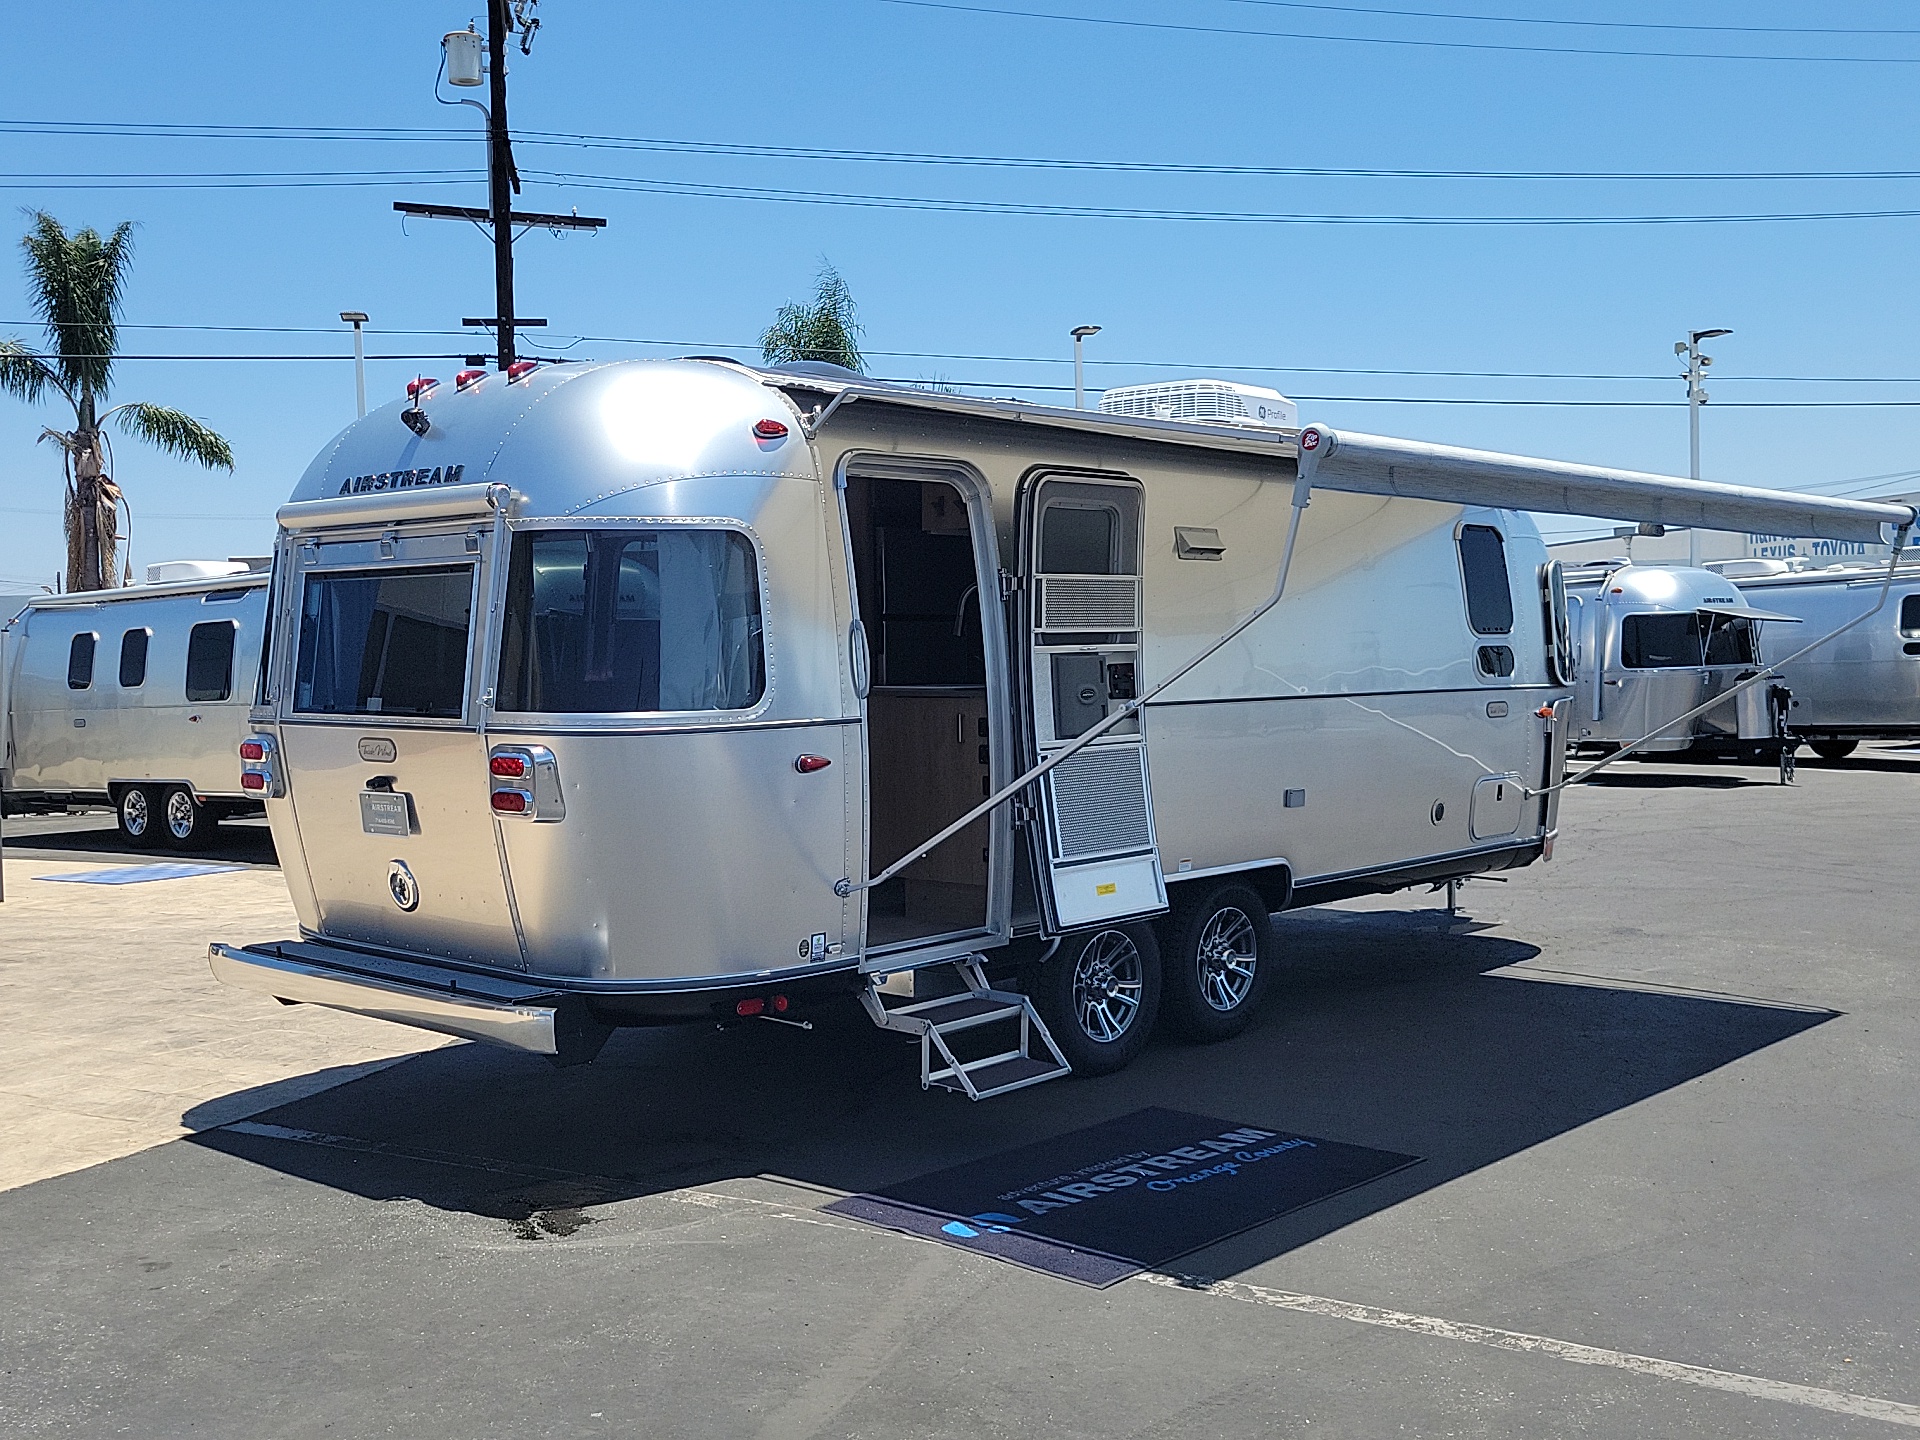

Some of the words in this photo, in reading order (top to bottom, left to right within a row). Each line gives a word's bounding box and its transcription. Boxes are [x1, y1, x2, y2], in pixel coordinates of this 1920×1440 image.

[1267, 408, 1286, 420] Profile
[339, 464, 465, 495] AIRSTREAM
[371, 803, 402, 813] AIRSTREAM
[1016, 1127, 1278, 1215] AIRSTREAM
[1147, 1161, 1242, 1192] Orange
[1234, 1137, 1318, 1163] County
